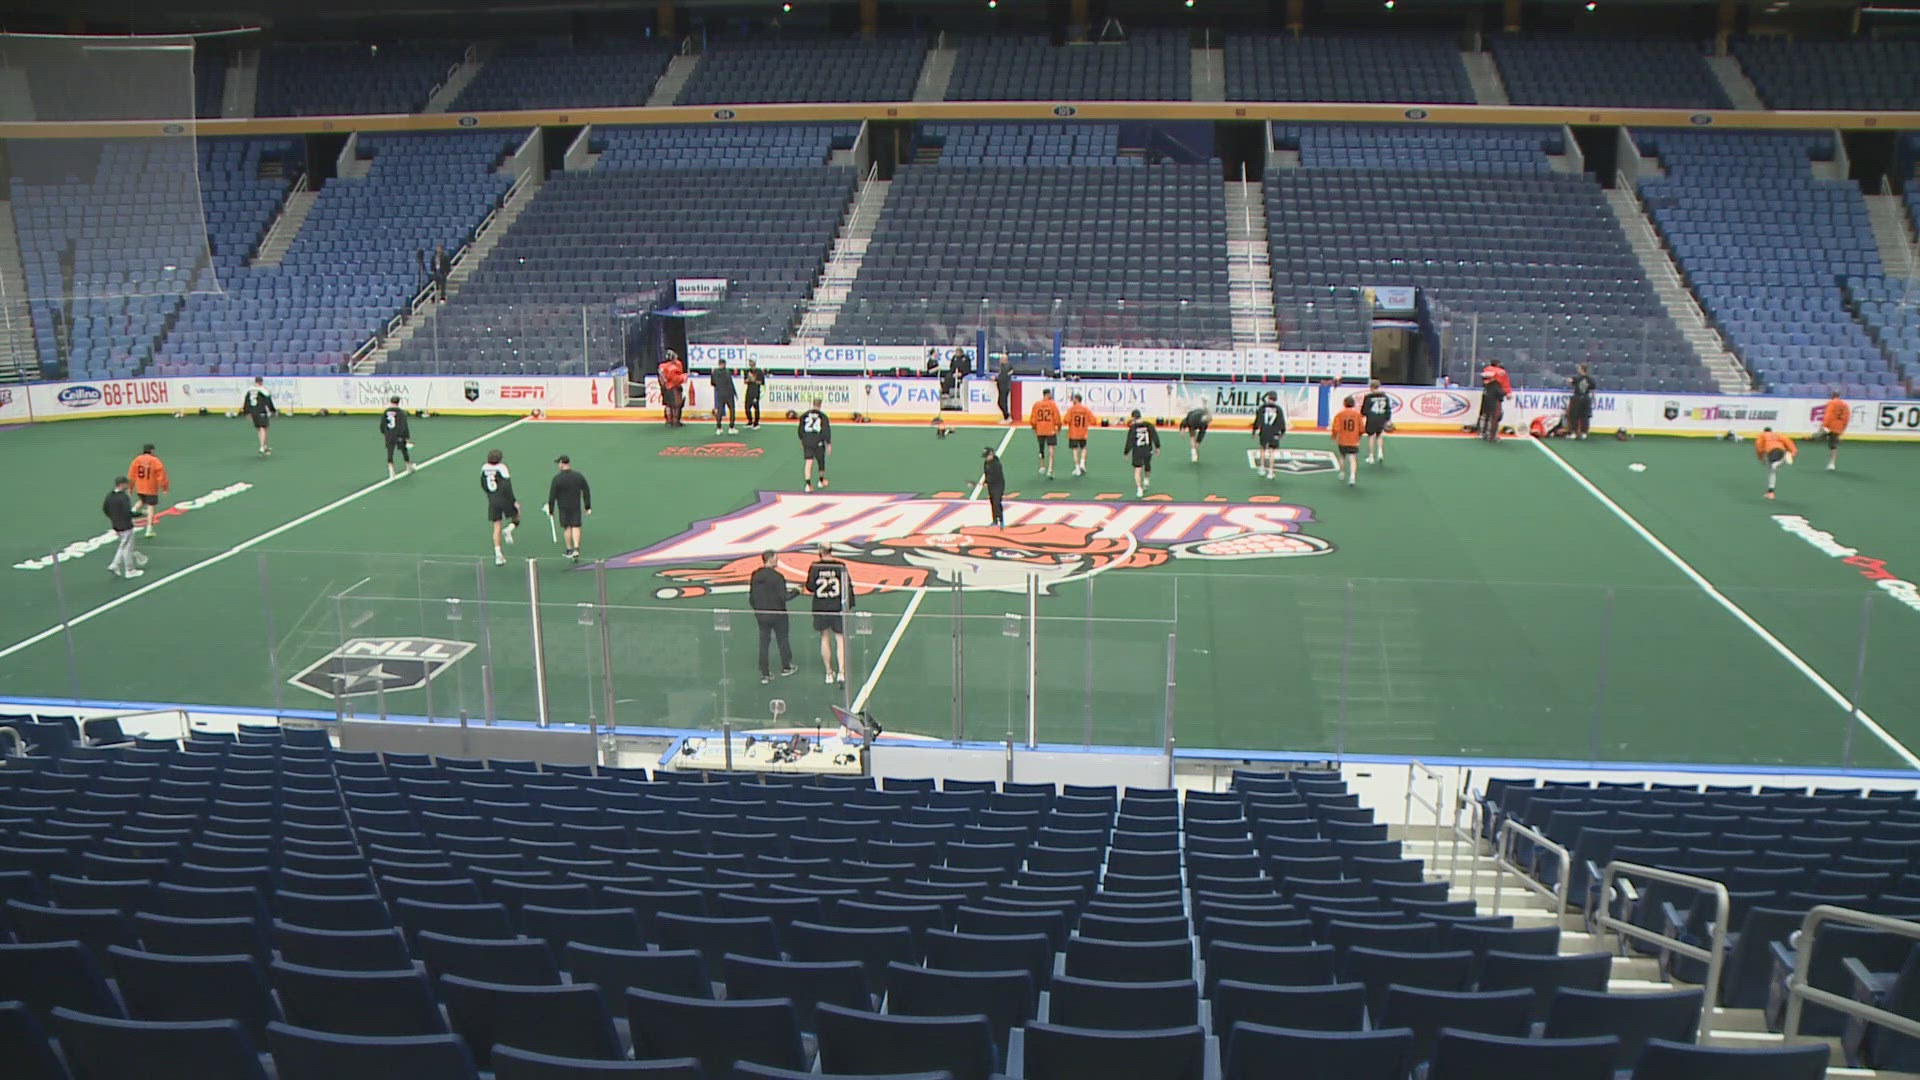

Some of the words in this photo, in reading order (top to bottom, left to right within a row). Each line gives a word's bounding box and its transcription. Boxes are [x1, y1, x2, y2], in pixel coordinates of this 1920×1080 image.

[678, 284, 710, 292] austin
[712, 284, 726, 292] air
[707, 347, 746, 360] CFBT
[825, 349, 864, 361] CFBT
[62, 389, 99, 399] Cellino
[103, 381, 168, 406] 68-FLUSH
[358, 380, 410, 395] NIAGARA
[501, 386, 544, 398] ESPN
[908, 388, 992, 403] FANEL
[1421, 393, 1442, 405] delta
[1515, 394, 1542, 409] NEW
[1371, 400, 1387, 414] 42
[1421, 404, 1442, 414] sonic
[1037, 408, 1051, 422] 92
[1074, 415, 1086, 428] 91
[1264, 410, 1278, 426] 17
[804, 417, 822, 433] 24
[1136, 430, 1150, 447] 21
[137, 465, 151, 480] 81
[610, 491, 1314, 565] BANDITS
[815, 577, 841, 599] 23
[345, 640, 451, 659] NLL
